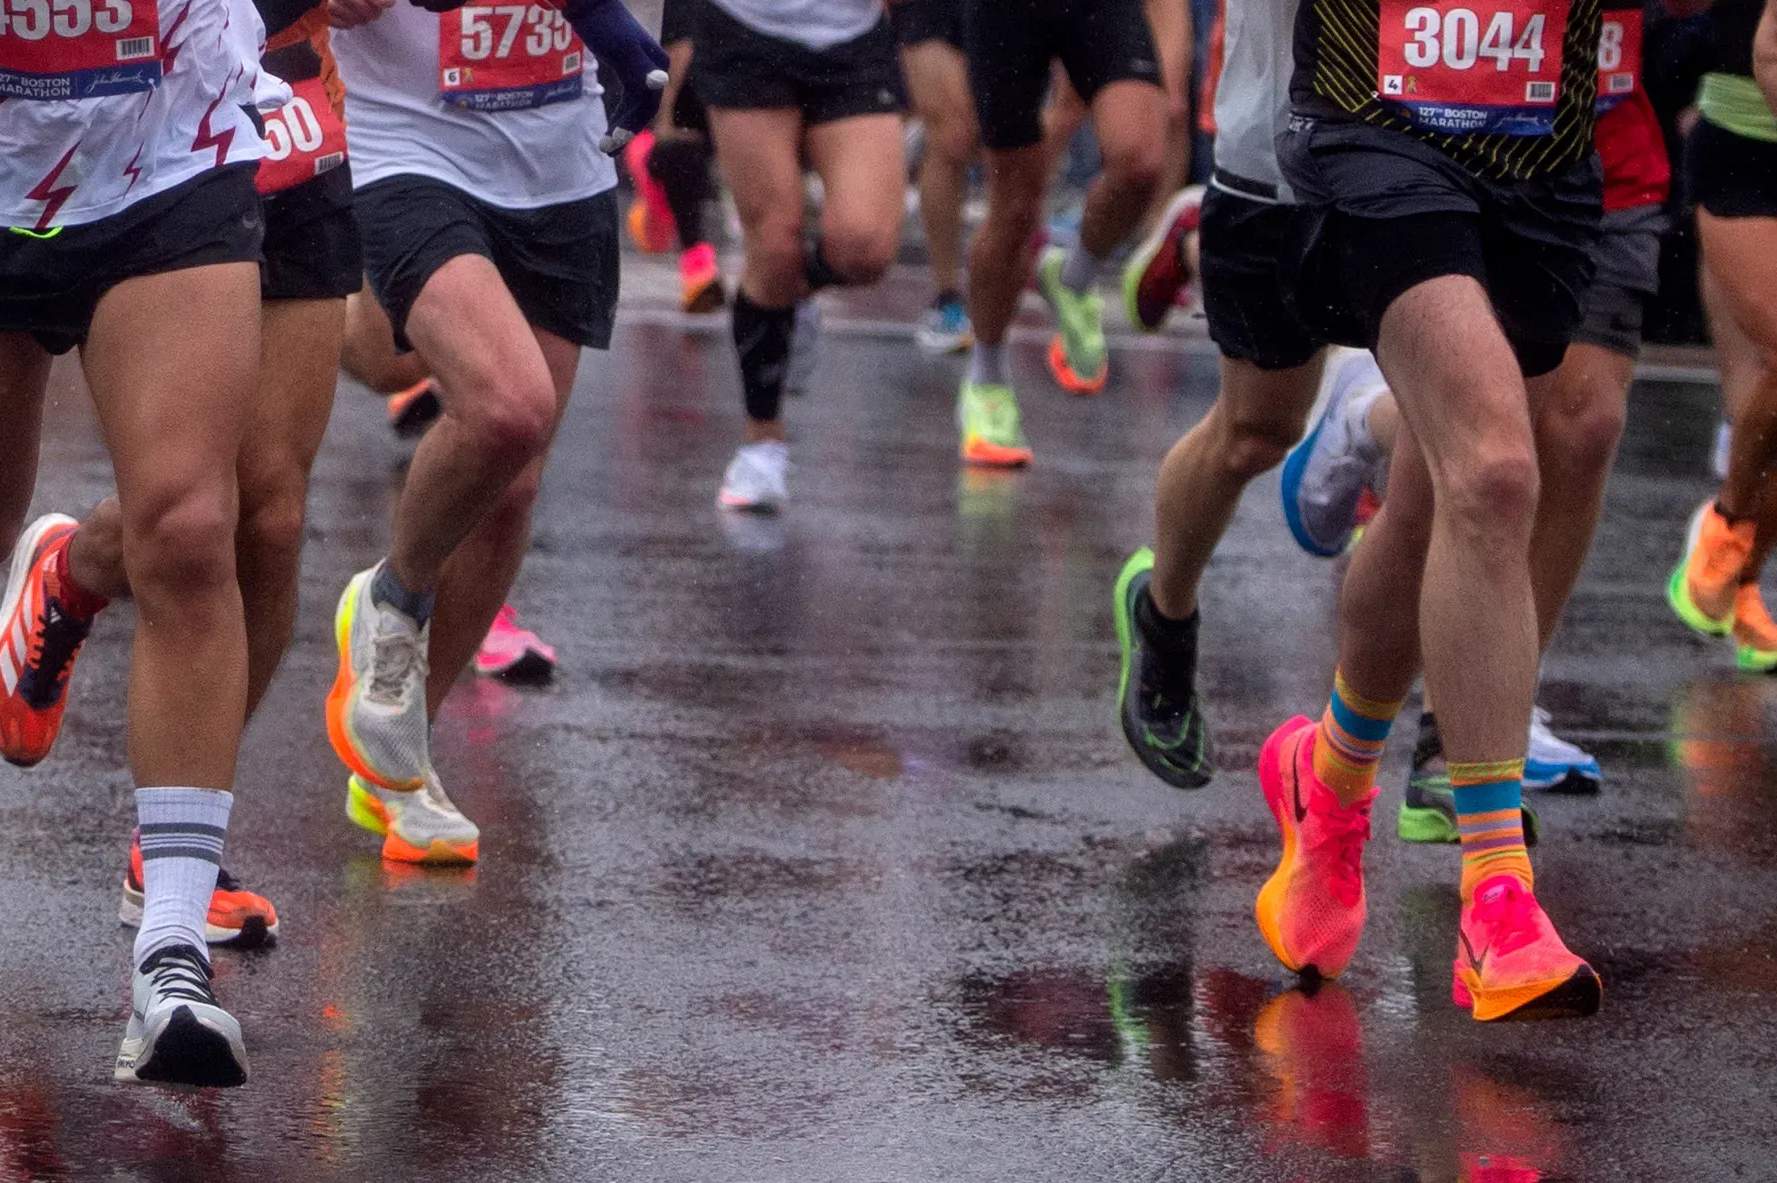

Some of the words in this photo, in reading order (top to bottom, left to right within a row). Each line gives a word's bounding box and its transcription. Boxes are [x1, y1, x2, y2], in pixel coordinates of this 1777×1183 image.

[461, 4, 572, 60] 5735
[1403, 7, 1546, 73] 3044
[21, 76, 71, 89] BOSTON
[448, 71, 457, 83] 6
[1388, 80, 1399, 91] 4
[1444, 108, 1488, 119] BOSTON
[1418, 116, 1487, 129] MARATHON
